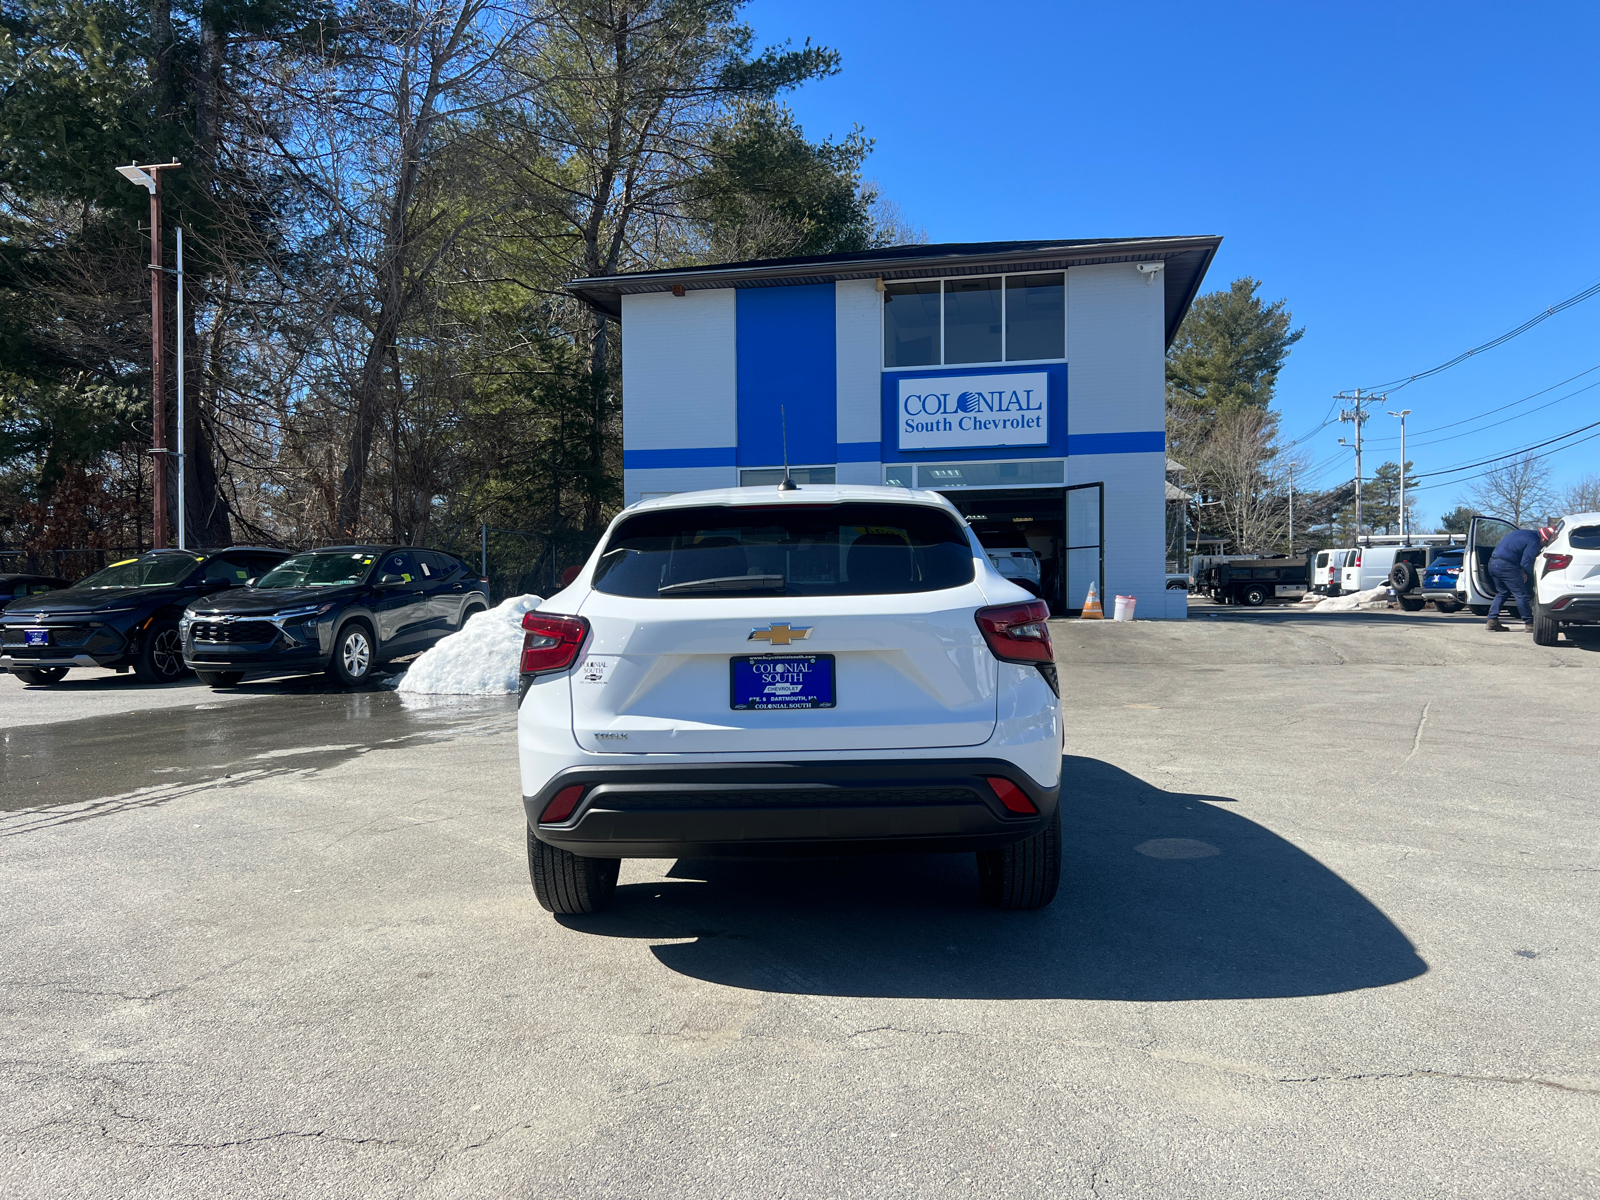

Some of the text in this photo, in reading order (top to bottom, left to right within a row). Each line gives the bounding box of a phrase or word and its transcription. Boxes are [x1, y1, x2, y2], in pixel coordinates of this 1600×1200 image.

[904, 390, 1042, 416] COLONIAL
[905, 414, 1042, 433] South Chevrolet
[753, 663, 812, 674] COLONIAL
[762, 673, 803, 683] SOUTH
[593, 732, 628, 740] TRAX
